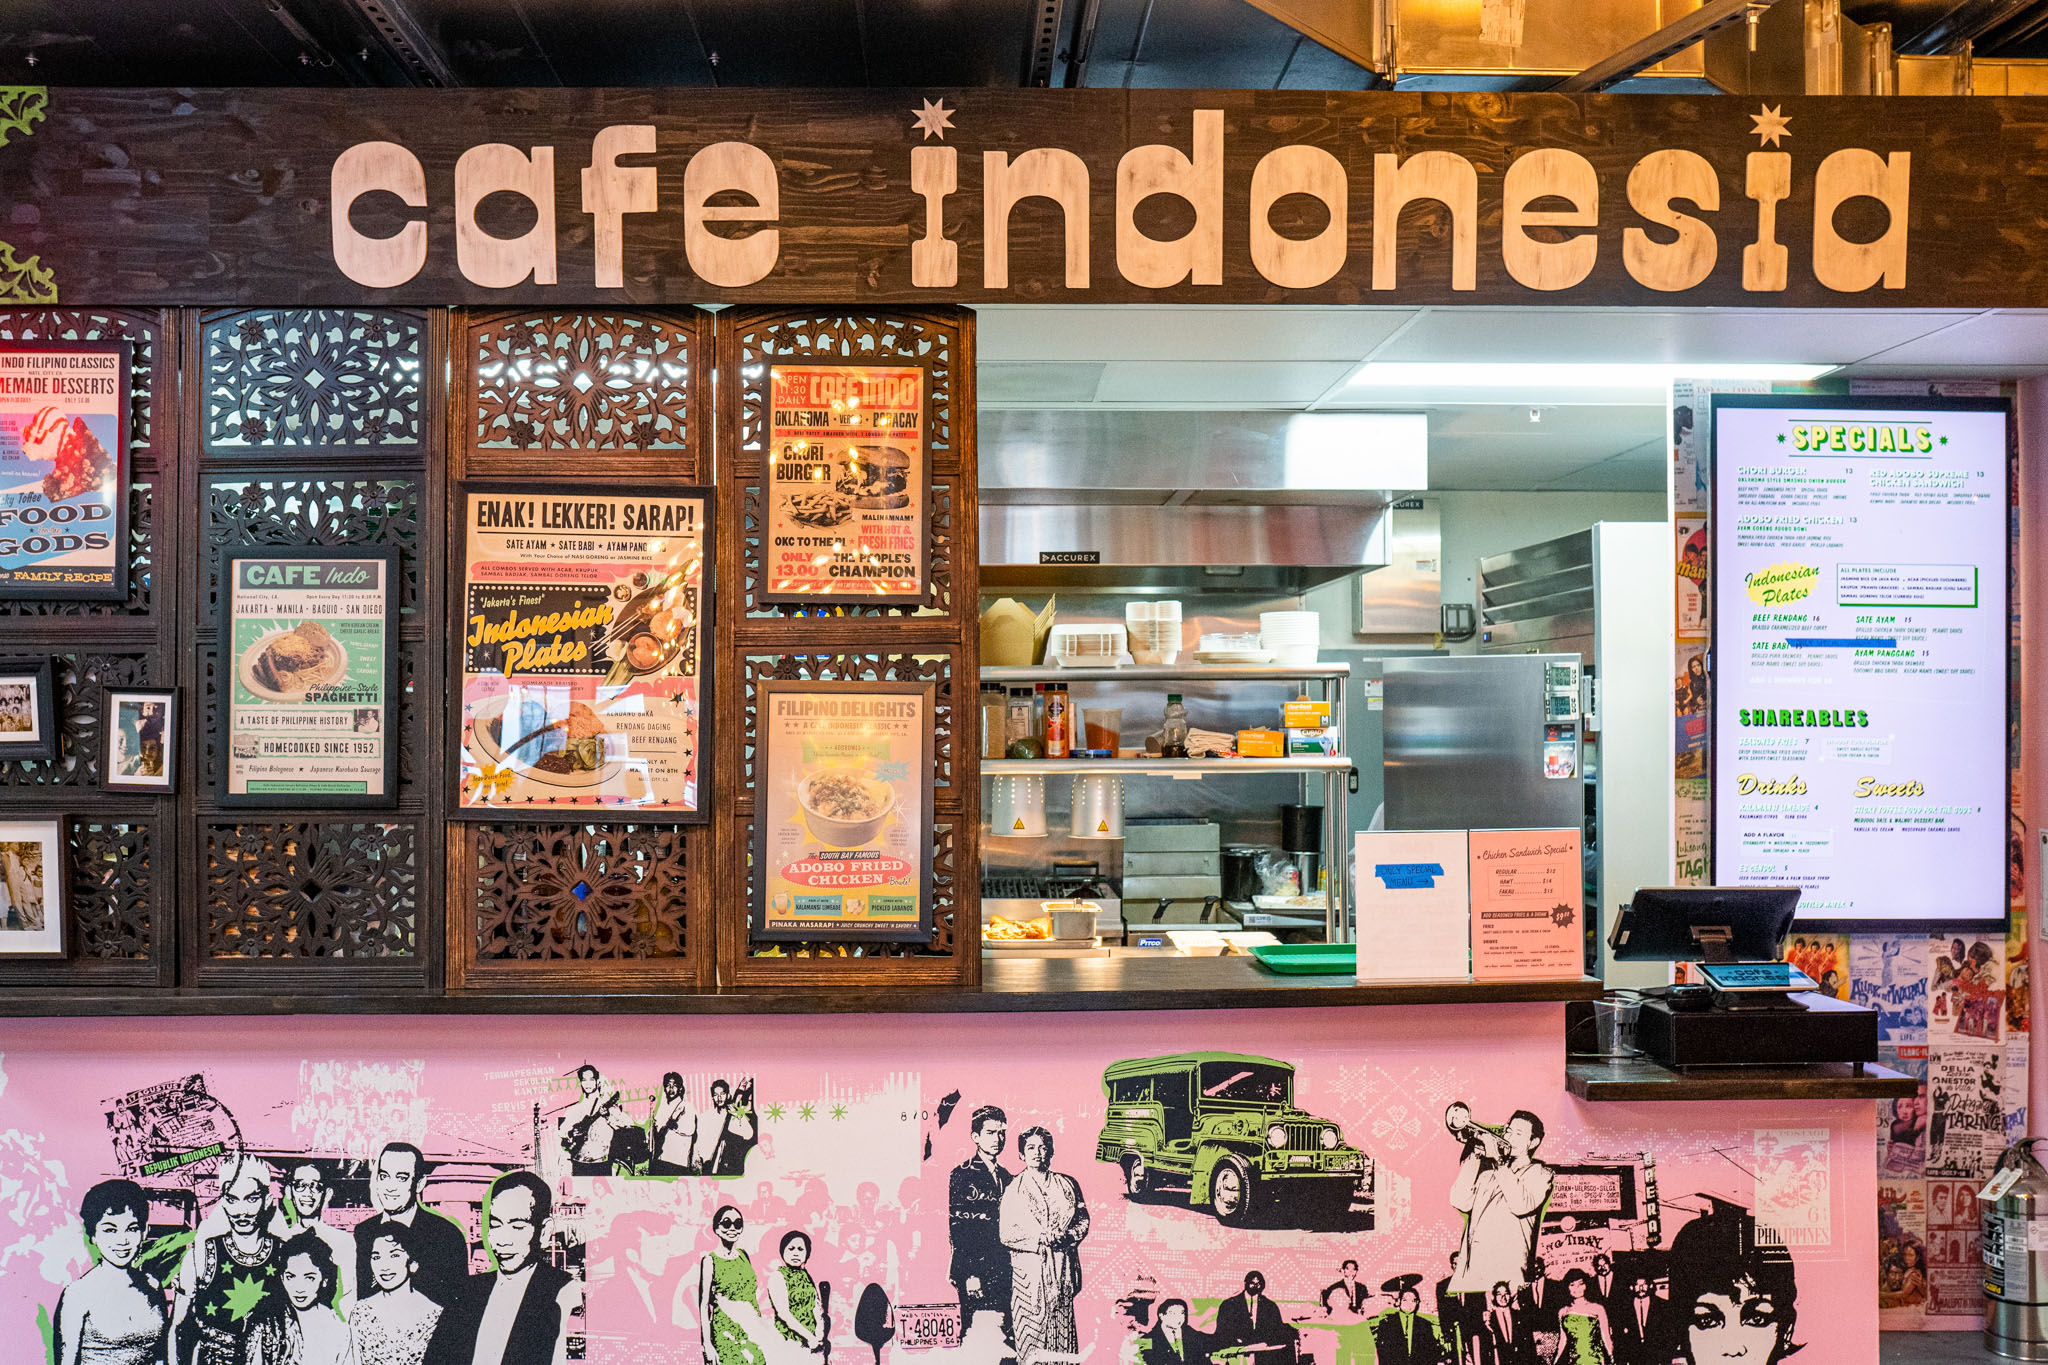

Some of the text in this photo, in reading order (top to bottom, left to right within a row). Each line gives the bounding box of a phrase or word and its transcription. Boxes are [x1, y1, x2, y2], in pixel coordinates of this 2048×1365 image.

[331, 96, 1912, 292] cafe indonesia
[1, 357, 115, 369] INDO FILIPINO CLASSICS
[779, 386, 806, 394] 11:30
[810, 376, 915, 406] CAFE INDO
[777, 396, 806, 404] DAILY
[1792, 424, 1933, 453] SPECIALS
[1770, 466, 1807, 475] BURGER
[1928, 471, 1969, 479] SUPREME
[1913, 480, 1965, 488] SANDWICH
[0, 504, 112, 525] FOOD
[477, 501, 694, 532] ENAK! LEKKER! SARAP!
[1775, 515, 1801, 524] FRIED
[1803, 515, 1844, 525] CHICKEN
[861, 525, 912, 534] WITH HOT &
[0, 532, 110, 554] GODS
[775, 537, 794, 546] OKC
[797, 537, 811, 546] TO
[813, 537, 833, 546] THE
[858, 535, 915, 550] FRESH FRIES
[781, 553, 813, 562] ONLY
[1050, 554, 1096, 562] ACCUREX
[14, 571, 112, 583] FAMILY RECIPE
[247, 565, 370, 585] CAFE Indo
[776, 565, 916, 578] 13.00 CHAMPION
[1744, 566, 1820, 589] Indonesian
[1762, 588, 1809, 607] Plates
[236, 604, 383, 614] JAKARTA MANILA BAGUIO SAN DIEGO
[468, 601, 614, 647] Indonesian
[1752, 614, 1771, 622] BEEF
[1773, 614, 1808, 622] RENDANG
[1855, 616, 1873, 624] SATE
[1876, 616, 1896, 624] AYAM
[1752, 642, 1769, 650] SATE
[1771, 642, 1790, 650] BABI
[501, 635, 588, 678] Plates
[1854, 649, 1874, 657] AYAM
[1876, 649, 1915, 657] PANGGANG
[309, 683, 379, 695] Philippine-Style
[305, 693, 377, 702] SPAGHETTI
[777, 700, 916, 718] FILIPINO DELIGHTS
[240, 716, 347, 725] A TASTE OF PHILIPPINE HISTORY
[1739, 709, 1869, 727] SHAREABLES
[616, 723, 671, 731] RENDANG DAGING
[632, 736, 678, 744] BEEF RENDANG
[264, 742, 374, 753] HOMECOOKED SINCE 1952
[249, 765, 267, 773] Filipino
[269, 765, 294, 774] Bolognese
[310, 765, 334, 774] Japanese
[335, 765, 359, 773] Kurobuta
[361, 765, 381, 775] Sausage
[1737, 773, 1924, 798] Drinks Sweets
[819, 852, 839, 860] SOUTH
[854, 851, 880, 859] FAMOUS
[1482, 843, 1568, 860] Chicken Sandwich Special
[789, 861, 903, 873] ADOBO FRIED
[1407, 865, 1437, 875] SPECIAL
[808, 874, 883, 885] CHICKEN
[1389, 878, 1413, 887] MENU
[1734, 968, 1772, 976] cafe
[1850, 977, 1928, 1004] ANAK WARAY
[138, 1083, 181, 1097] AGUSTUS
[491, 1100, 526, 1112] SERVIS
[144, 1144, 221, 1175] REPUBLIK INDONESIA
[121, 1163, 137, 1176] 75
[1565, 1234, 1604, 1249] TIBAY
[1757, 1228, 1829, 1244] PHILIPPINES
